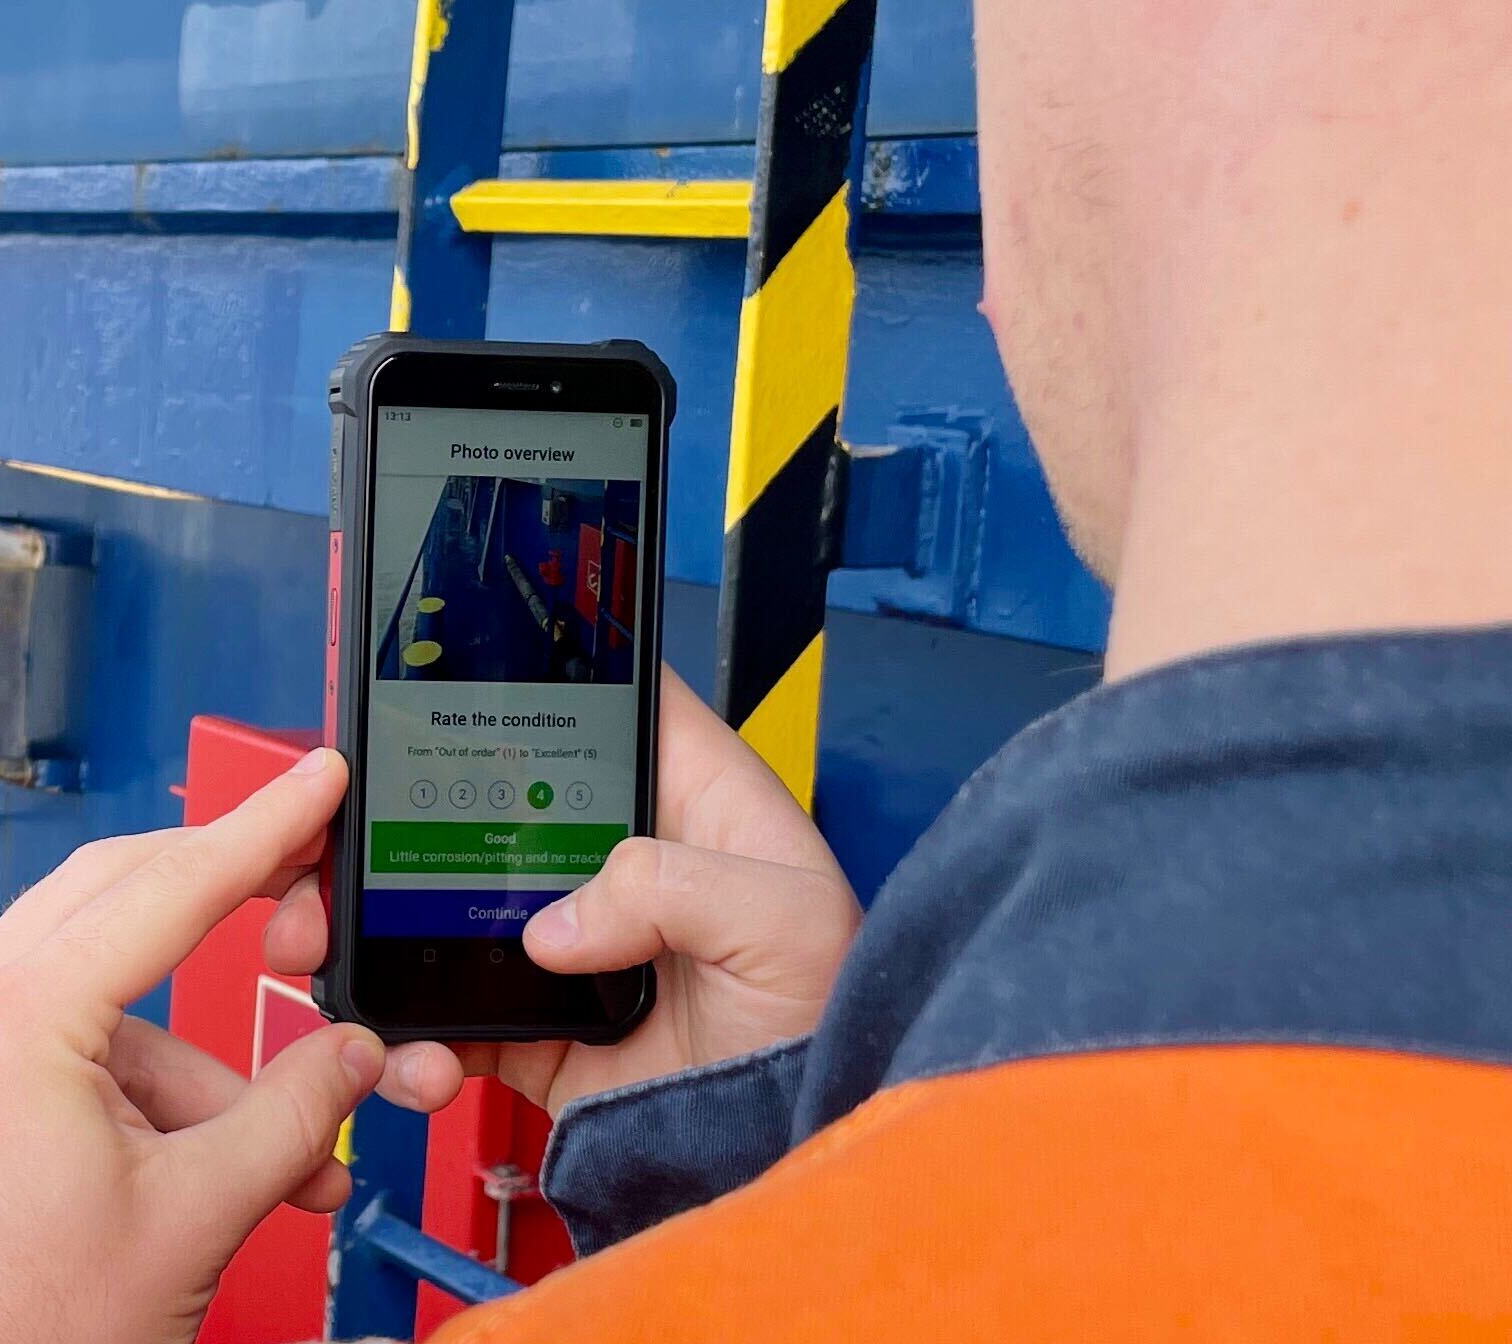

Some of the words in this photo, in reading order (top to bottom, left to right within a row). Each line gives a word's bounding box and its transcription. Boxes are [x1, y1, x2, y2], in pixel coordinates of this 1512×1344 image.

[450, 443, 499, 460] Photo
[503, 446, 575, 462] overview
[431, 711, 467, 726] Rate
[472, 712, 497, 727] the
[501, 712, 576, 728] condition
[407, 746, 433, 756] From
[458, 746, 470, 757] of
[502, 748, 516, 760] (1)
[519, 748, 529, 758] to
[583, 749, 597, 761] (5)
[458, 788, 467, 801] 2
[498, 788, 506, 801] 3
[536, 789, 544, 801] 4
[484, 832, 517, 845] Good
[389, 850, 420, 863] Little
[422, 851, 522, 866] corrosion/pitting
[525, 852, 548, 864] and
[550, 854, 566, 864] no
[468, 906, 529, 920] Continue
